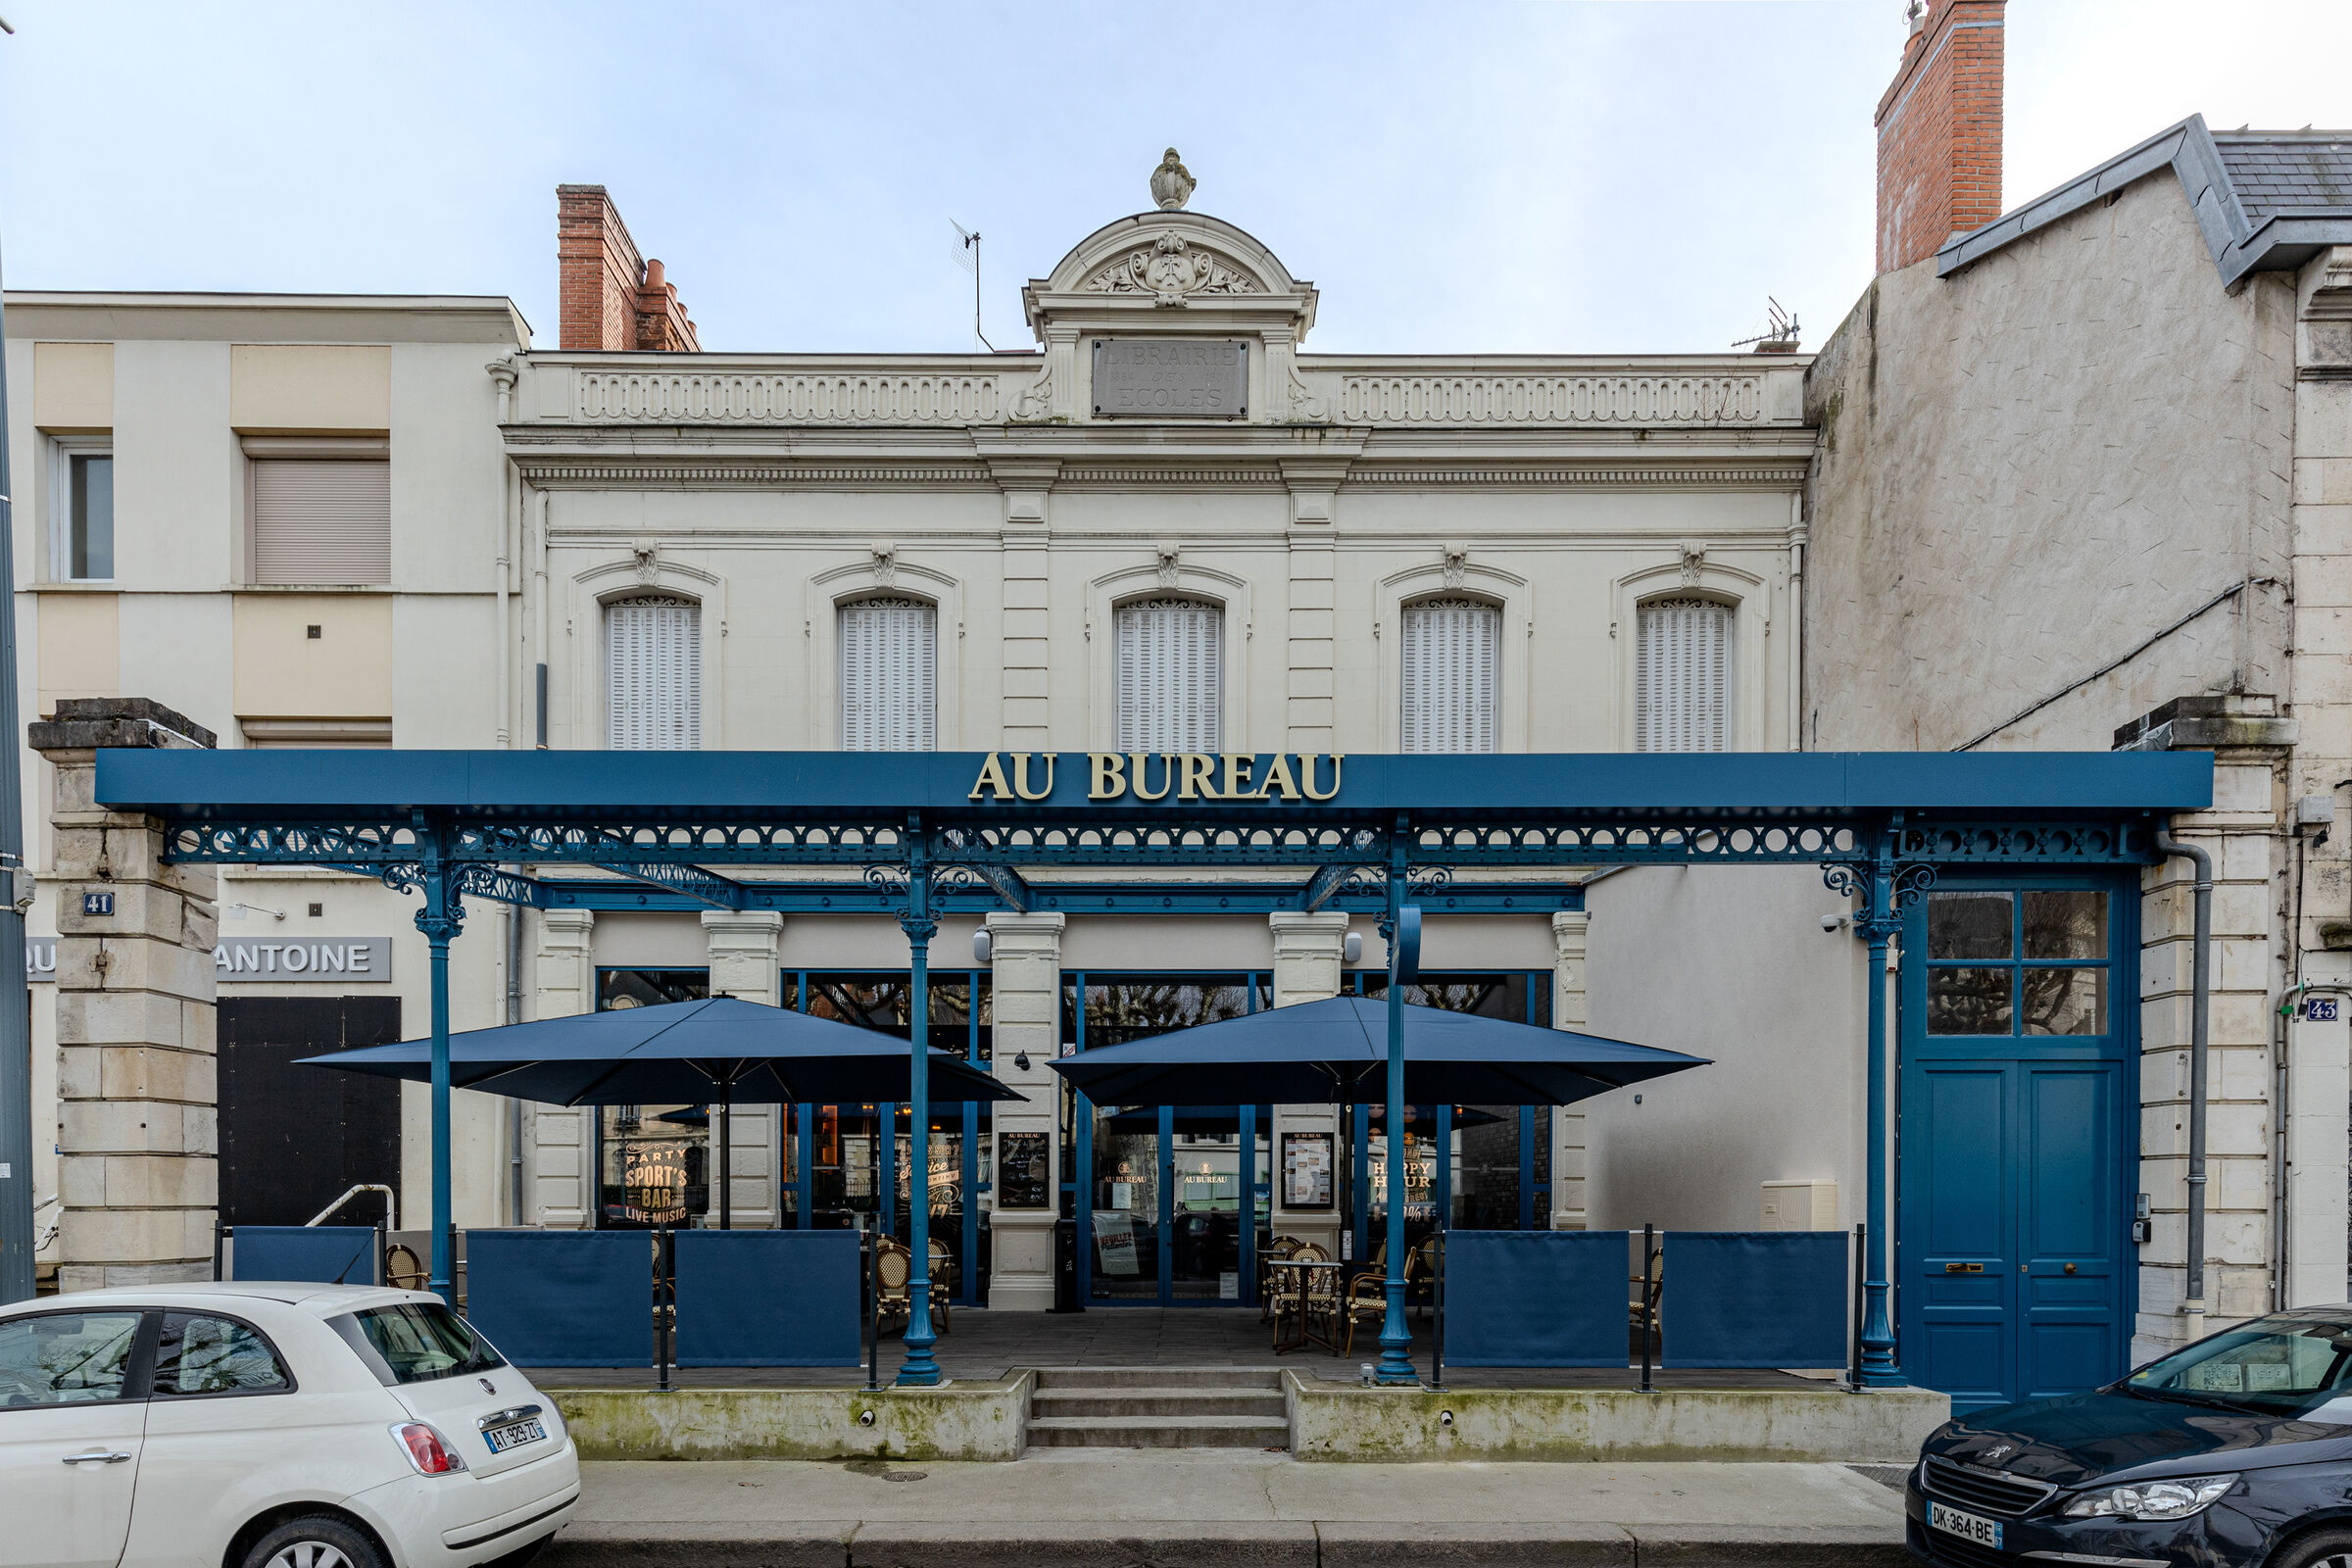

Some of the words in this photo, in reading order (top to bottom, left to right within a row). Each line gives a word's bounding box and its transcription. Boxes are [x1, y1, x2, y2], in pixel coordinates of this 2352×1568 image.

[1104, 347, 1239, 367] LIBRAIRIE
[1118, 388, 1222, 408] ECOLES
[967, 752, 1057, 801] AU
[1087, 753, 1346, 801] BUREAU
[87, 895, 108, 912] 41
[2311, 1001, 2336, 1019] 43
[626, 1149, 686, 1164] PARTY
[625, 1165, 687, 1187] SPORT'S
[1373, 1162, 1431, 1174] HPPY
[1373, 1176, 1431, 1188] HUR
[642, 1188, 671, 1209] BAR
[625, 1206, 649, 1223] LIVE
[652, 1206, 686, 1223] MUSIC
[1934, 1506, 1993, 1544] DK-364-BE
